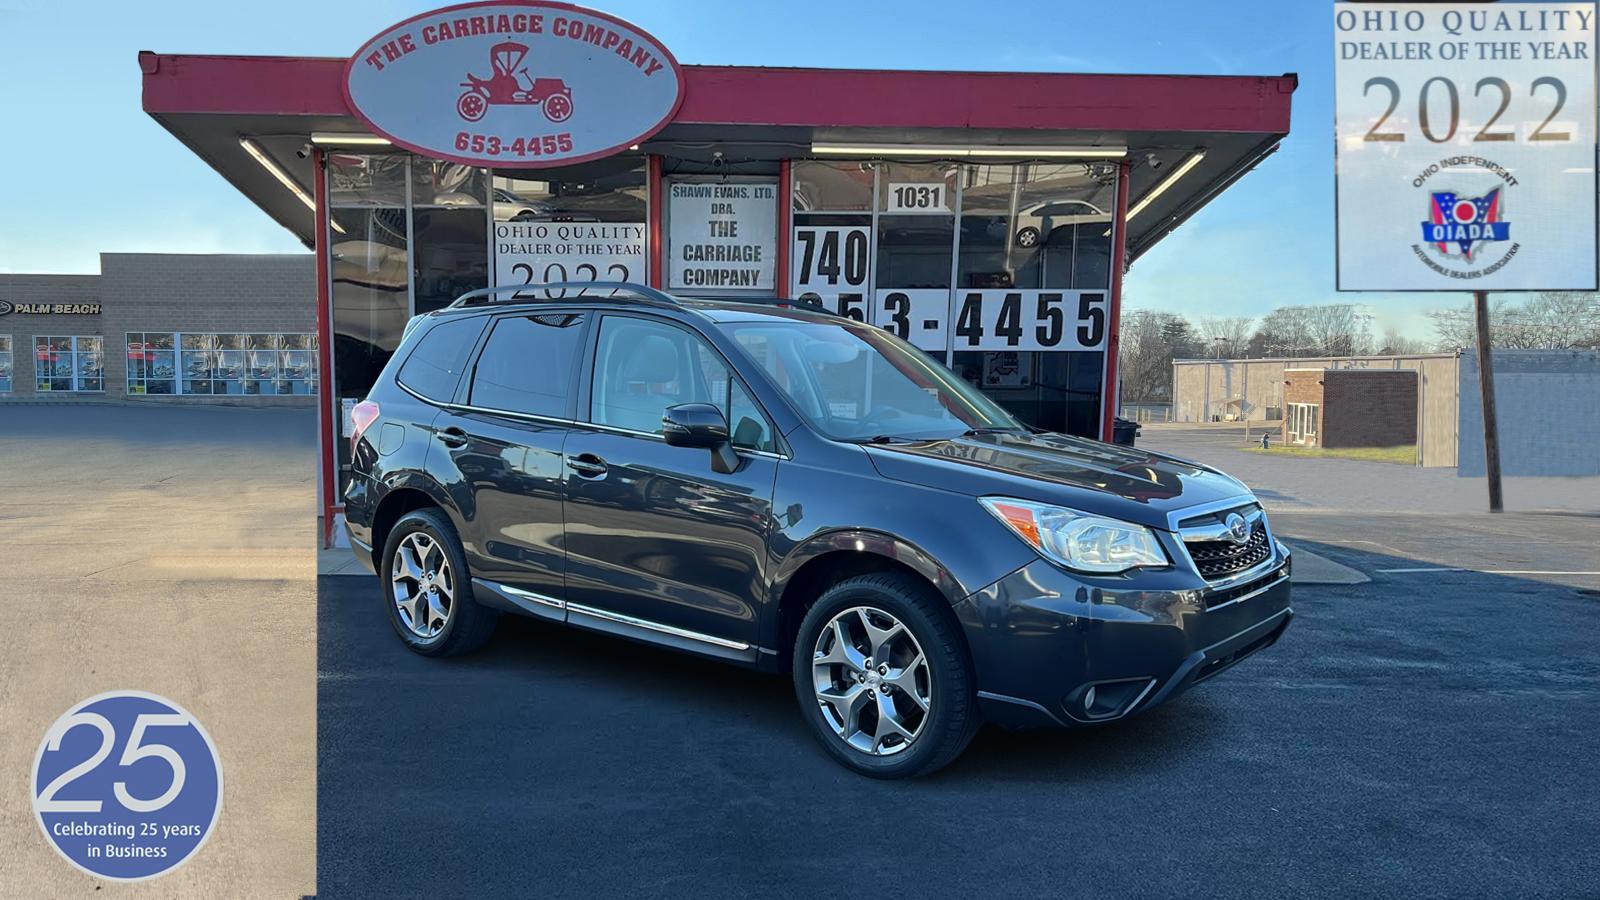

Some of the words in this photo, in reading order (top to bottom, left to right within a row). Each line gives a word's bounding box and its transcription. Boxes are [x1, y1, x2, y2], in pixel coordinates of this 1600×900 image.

[1336, 10, 1425, 31] OHIO
[1442, 10, 1593, 35] QUALITY
[365, 33, 416, 71] THE
[422, 14, 544, 45] CARRIAGE
[552, 17, 664, 77] COMPANY
[1340, 41, 1433, 60] DEALER
[1439, 41, 1469, 60] OF
[1475, 41, 1522, 60] THE
[1528, 41, 1589, 60] YEAR
[1363, 76, 1571, 143] 2022
[455, 132, 573, 156] 653-4455
[1412, 164, 1440, 188] OHIO
[1439, 155, 1519, 187] INDEPENDENT
[672, 186, 712, 199] SHAWN
[754, 187, 775, 200] LTD.
[894, 187, 941, 208] 1031
[711, 203, 736, 215] DBA.
[497, 225, 548, 239] OHIO
[557, 225, 644, 241] QUALITY
[708, 220, 738, 238] THE
[1432, 224, 1495, 240] OIADA
[499, 243, 552, 255] DEALER
[555, 243, 573, 255] OF
[576, 244, 603, 255] THE
[607, 244, 641, 255] YEAR
[683, 244, 762, 262] CARRIAGE
[797, 230, 868, 286] 740
[511, 263, 629, 299] 2022
[683, 268, 761, 286] COMPANY
[15, 304, 51, 314] PALM
[54, 304, 100, 314] BEACH
